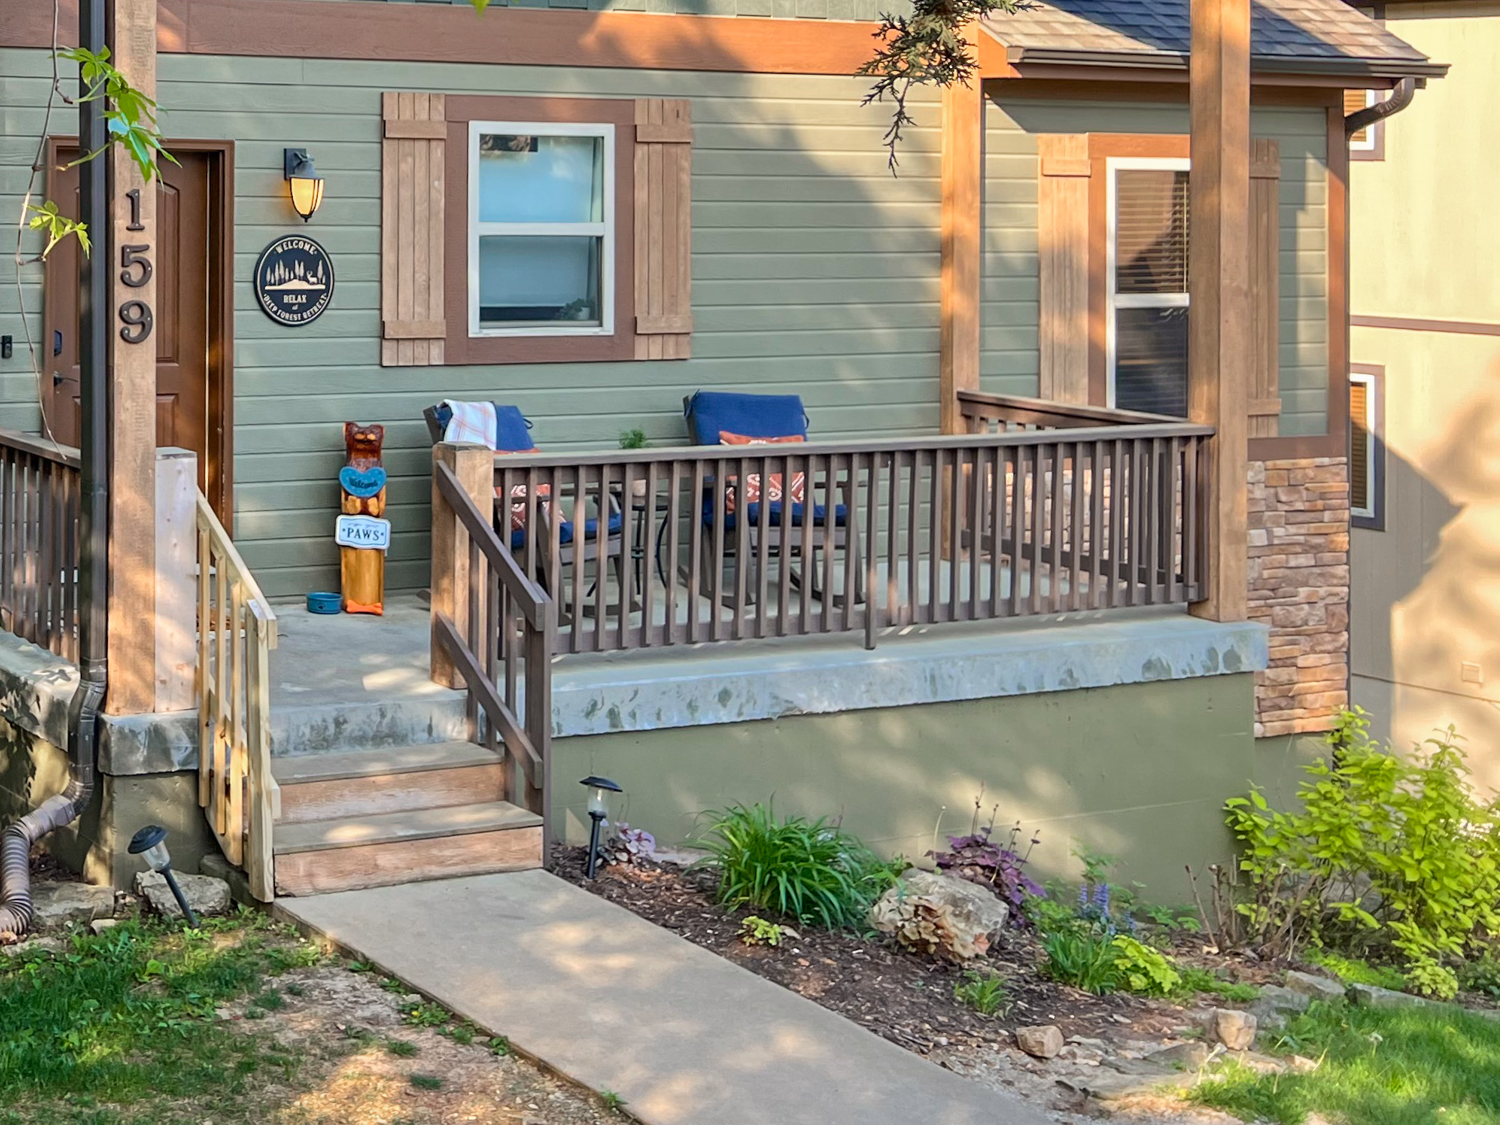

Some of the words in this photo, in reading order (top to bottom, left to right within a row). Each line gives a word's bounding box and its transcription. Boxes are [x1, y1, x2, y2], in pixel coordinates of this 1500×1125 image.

[275, 240, 317, 255] WELCOME
[119, 188, 153, 344] 159
[283, 294, 307, 304] RELAX
[277, 309, 302, 321] FOREST
[302, 294, 327, 319] RETREAT
[347, 527, 380, 541] PAWS
